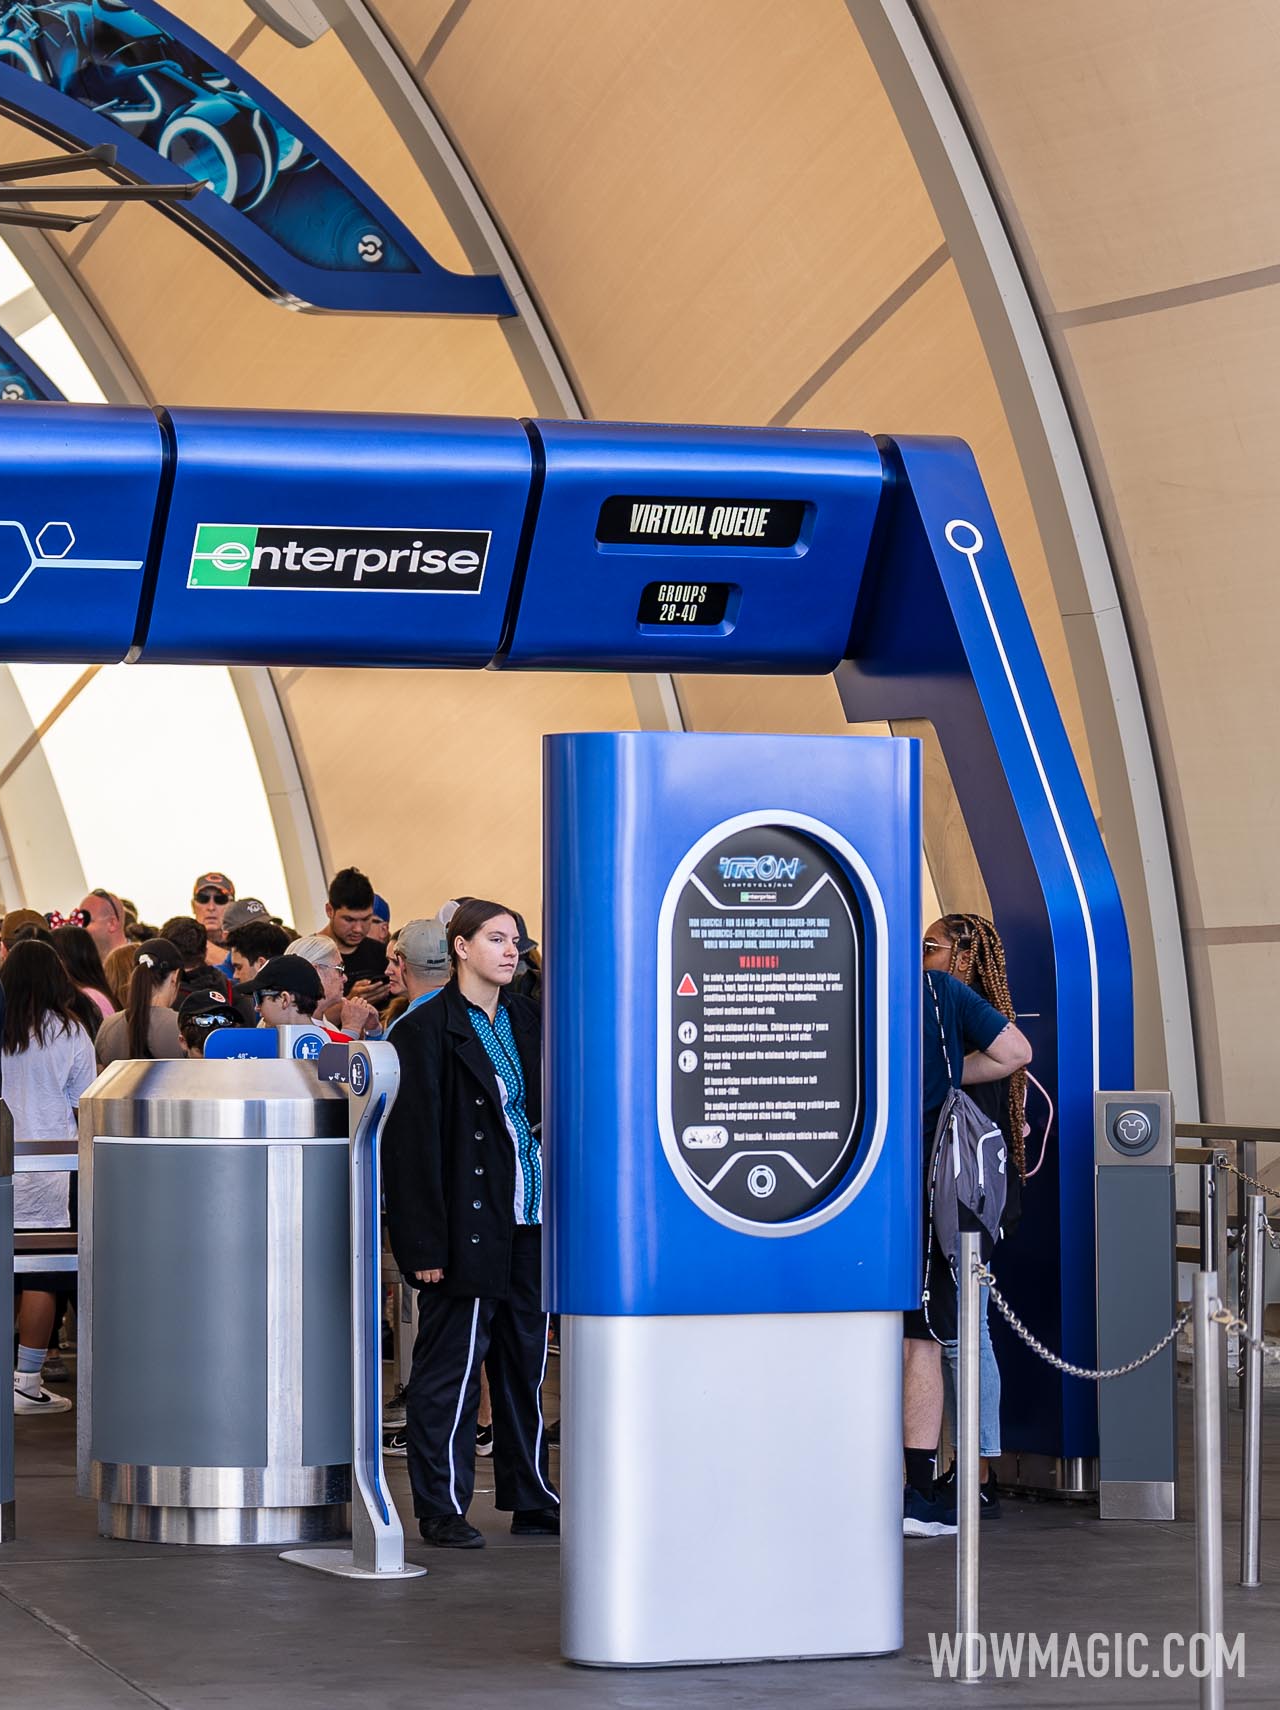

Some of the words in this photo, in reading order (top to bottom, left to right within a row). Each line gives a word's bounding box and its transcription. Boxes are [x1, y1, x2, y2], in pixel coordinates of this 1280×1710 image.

[629, 503, 705, 535] VIRTUAL
[708, 506, 770, 539] QUEUE
[208, 540, 480, 581] enterprise
[658, 584, 707, 603] GROUPS
[659, 604, 698, 622] 28-40
[719, 855, 800, 880] TRON
